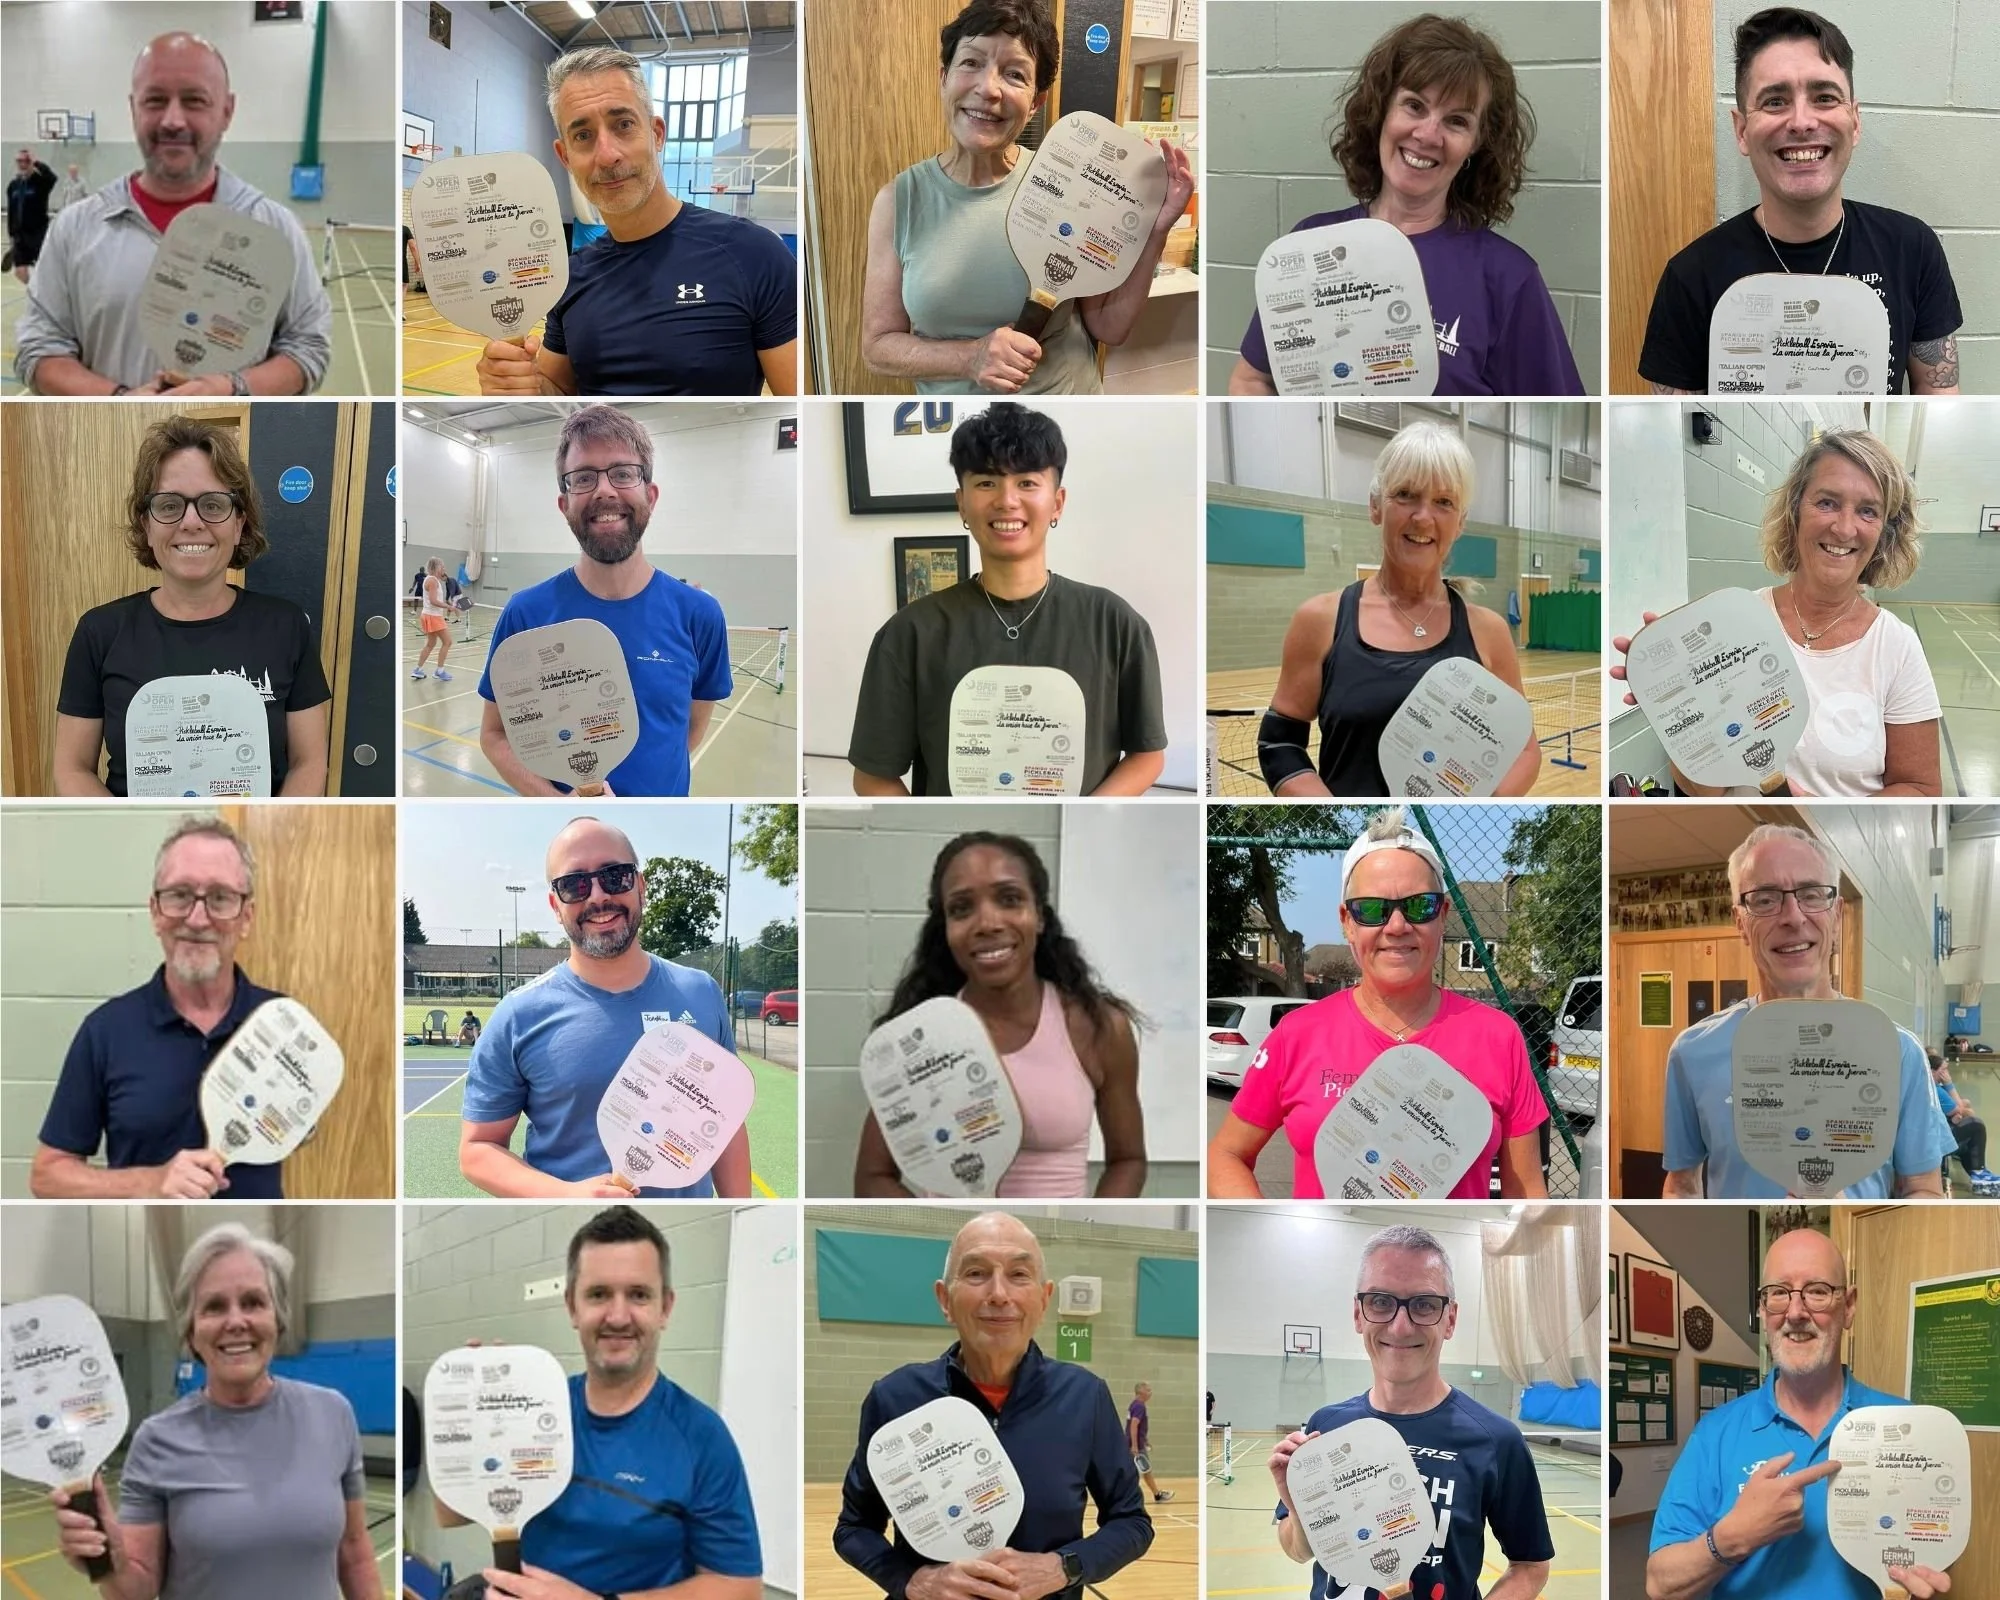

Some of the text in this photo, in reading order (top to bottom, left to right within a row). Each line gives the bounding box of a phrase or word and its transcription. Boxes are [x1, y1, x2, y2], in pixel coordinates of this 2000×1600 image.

[1078, 127, 1098, 141] OPEN
[1047, 255, 1076, 276] GERMAN
[1280, 257, 1304, 267] OPEN
[1315, 283, 1347, 297] Pickleball
[493, 301, 523, 314] GERMAN
[1775, 337, 1811, 347] Pickleball
[1362, 346, 1390, 354] SPANISH
[1362, 348, 1411, 359] PICKLEBALL
[894, 402, 954, 436] 20
[1745, 740, 1774, 762] GERMAN
[570, 752, 597, 765] GERMAN
[628, 1148, 653, 1169] GERMAN
[1800, 1162, 1834, 1172] GERMAN
[1060, 1325, 1088, 1337] Court
[1070, 1341, 1077, 1358] 1
[1372, 1550, 1400, 1566] GERMAN
[1883, 1551, 1913, 1561] GERMAN
